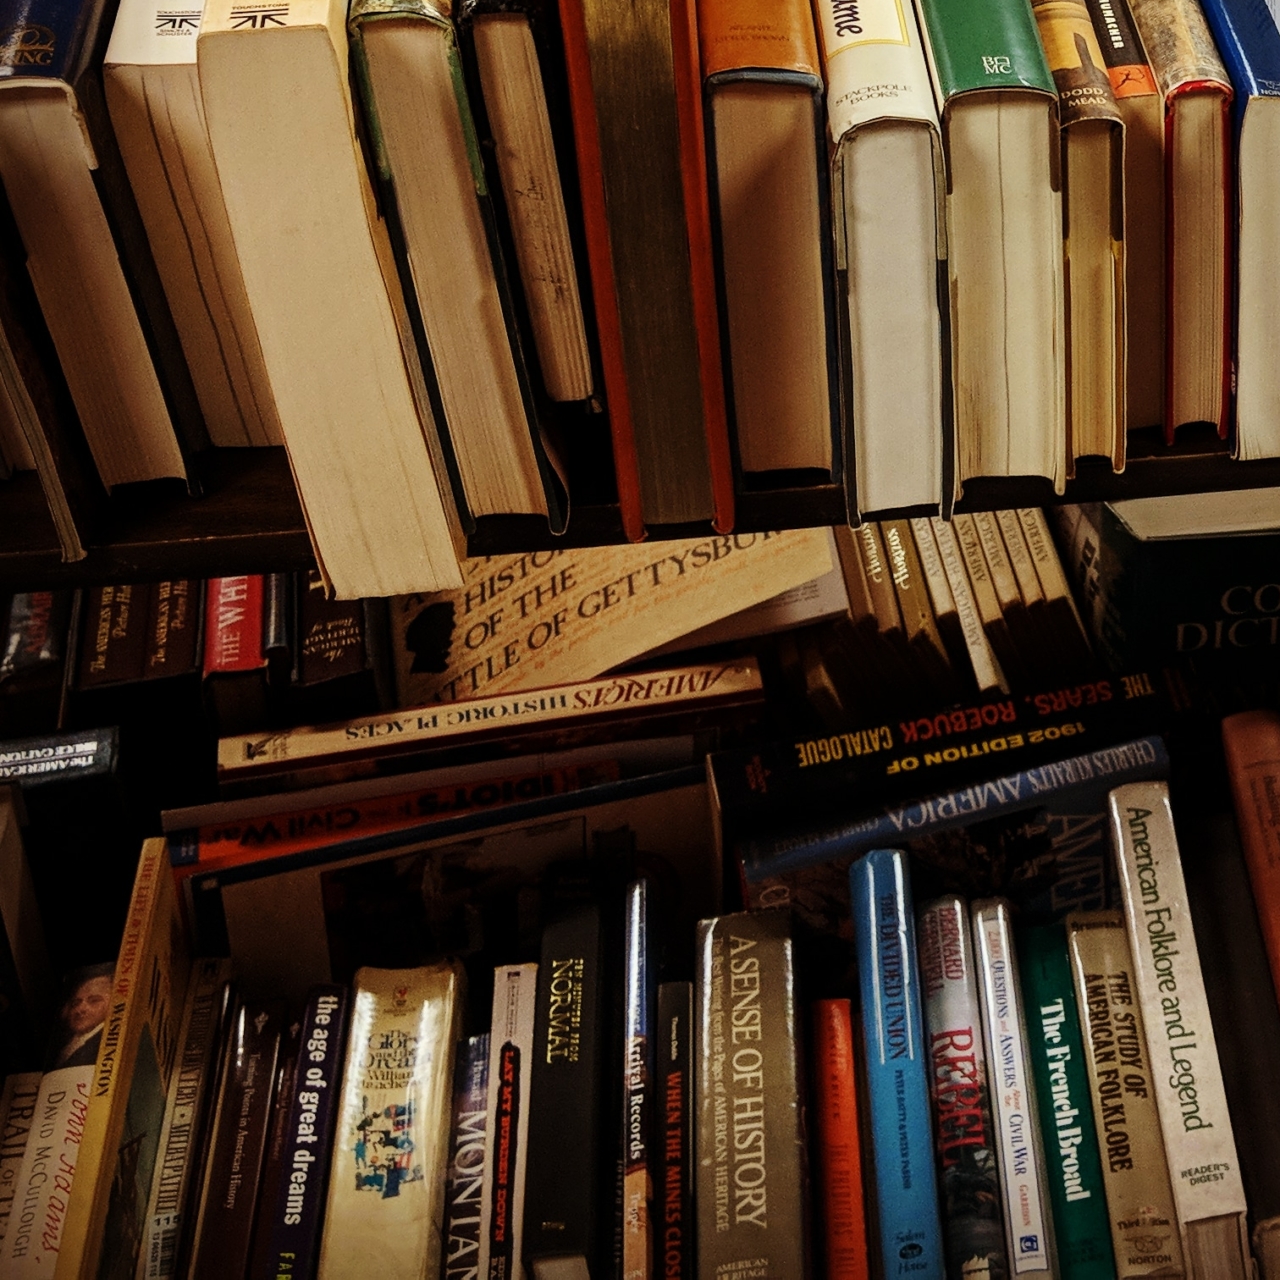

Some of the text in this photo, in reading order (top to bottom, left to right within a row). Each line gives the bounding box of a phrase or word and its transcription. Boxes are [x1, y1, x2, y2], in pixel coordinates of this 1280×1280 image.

[1068, 96, 1107, 106] MEAD
[464, 564, 578, 650] OF THE
[344, 665, 735, 743] AMERICA'S HISTORIC PLACES
[795, 726, 894, 767] CATALOGUE
[886, 721, 1086, 776] 1902 EDITION OF
[900, 673, 1156, 743] THE SEARS, ROEBUCK
[546, 959, 574, 1064] NORMAL
[1126, 805, 1214, 1134] American Folklore and Legend
[728, 935, 768, 1229] A SENSE OF HISTORY
[1084, 973, 1135, 1174] AMERICAN FOLKLORE
[1106, 970, 1149, 1100] THE STUDY OF
[283, 995, 339, 1226] the age of great dreams
[931, 1025, 986, 1167] REBEL
[1039, 998, 1092, 1203] The French Broad
[11, 1089, 67, 1259] DAVID McCULLOUGH
[1180, 1161, 1231, 1180] READER'S
[1189, 1170, 1226, 1187] DIGEST
[1127, 1253, 1173, 1267] NORTON
